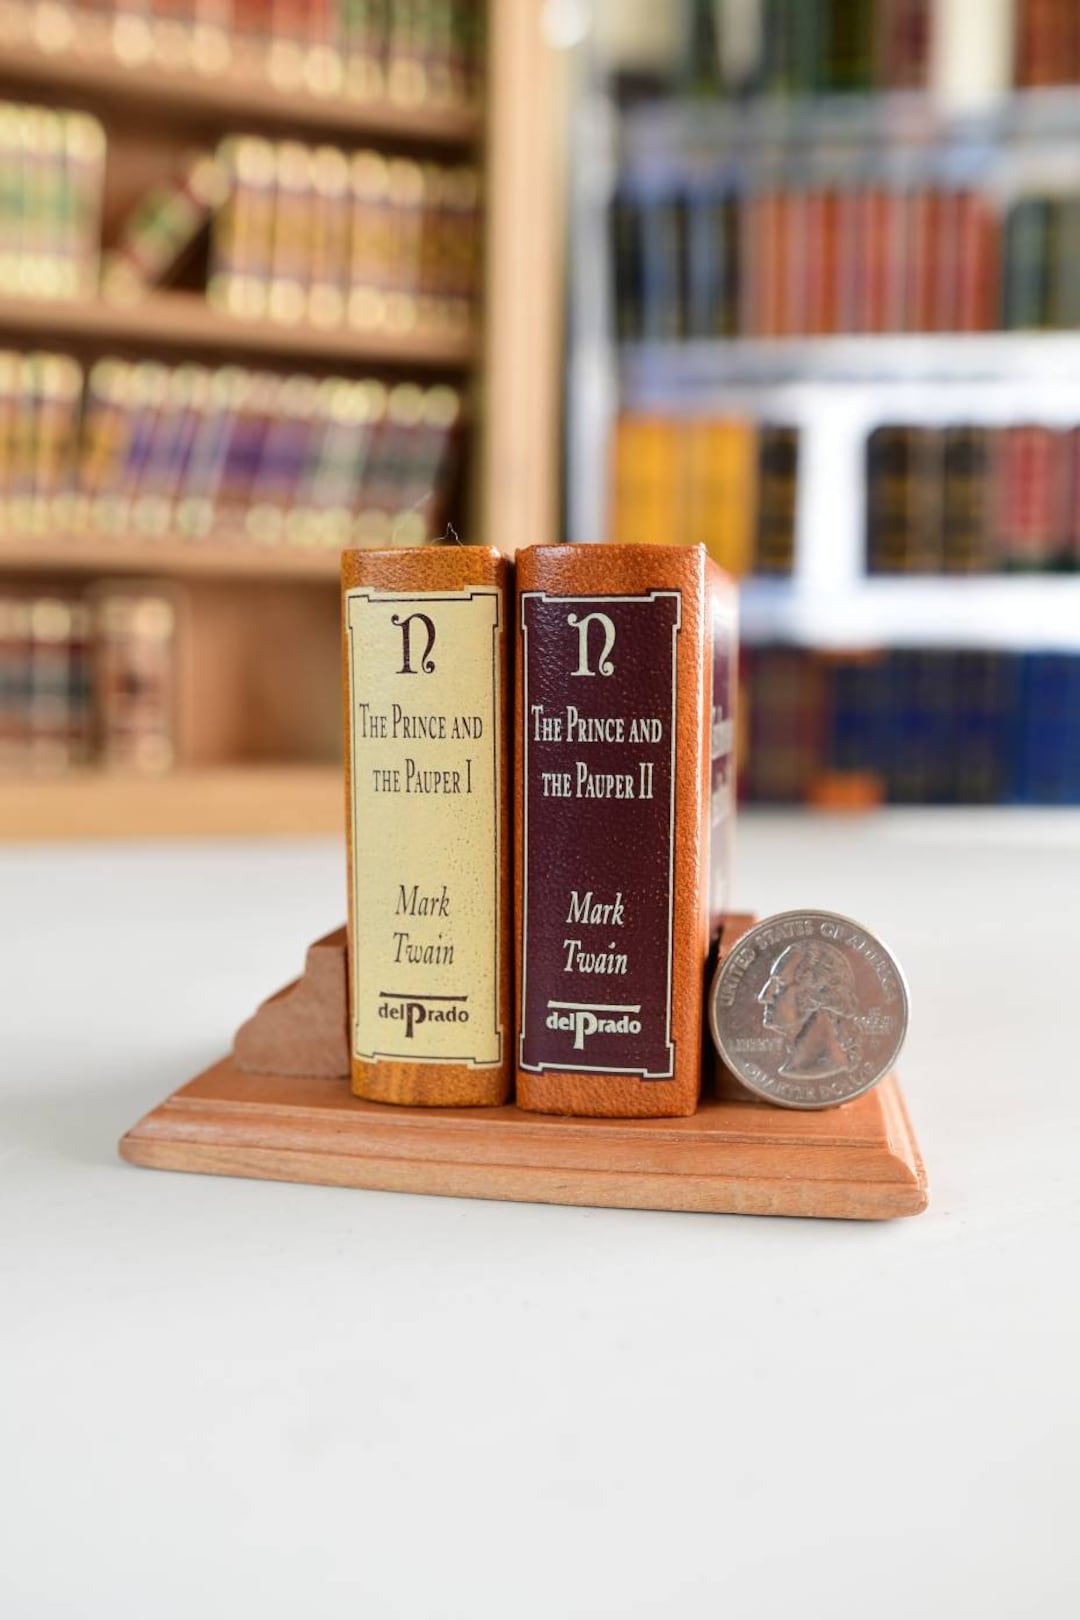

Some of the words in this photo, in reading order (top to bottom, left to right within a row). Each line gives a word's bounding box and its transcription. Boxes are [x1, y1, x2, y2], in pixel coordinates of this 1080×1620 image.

[452, 717, 483, 740] AND
[629, 719, 662, 743] AND
[372, 769, 401, 793] THE
[466, 758, 472, 794] I
[541, 773, 572, 798] THE
[638, 762, 654, 799] II
[395, 885, 450, 917] Mark
[566, 891, 625, 925] Mark
[393, 932, 454, 965] Twain
[563, 939, 628, 975] Twain
[721, 949, 755, 1006] UNITED
[756, 920, 814, 950] STATES
[820, 922, 842, 938] OF
